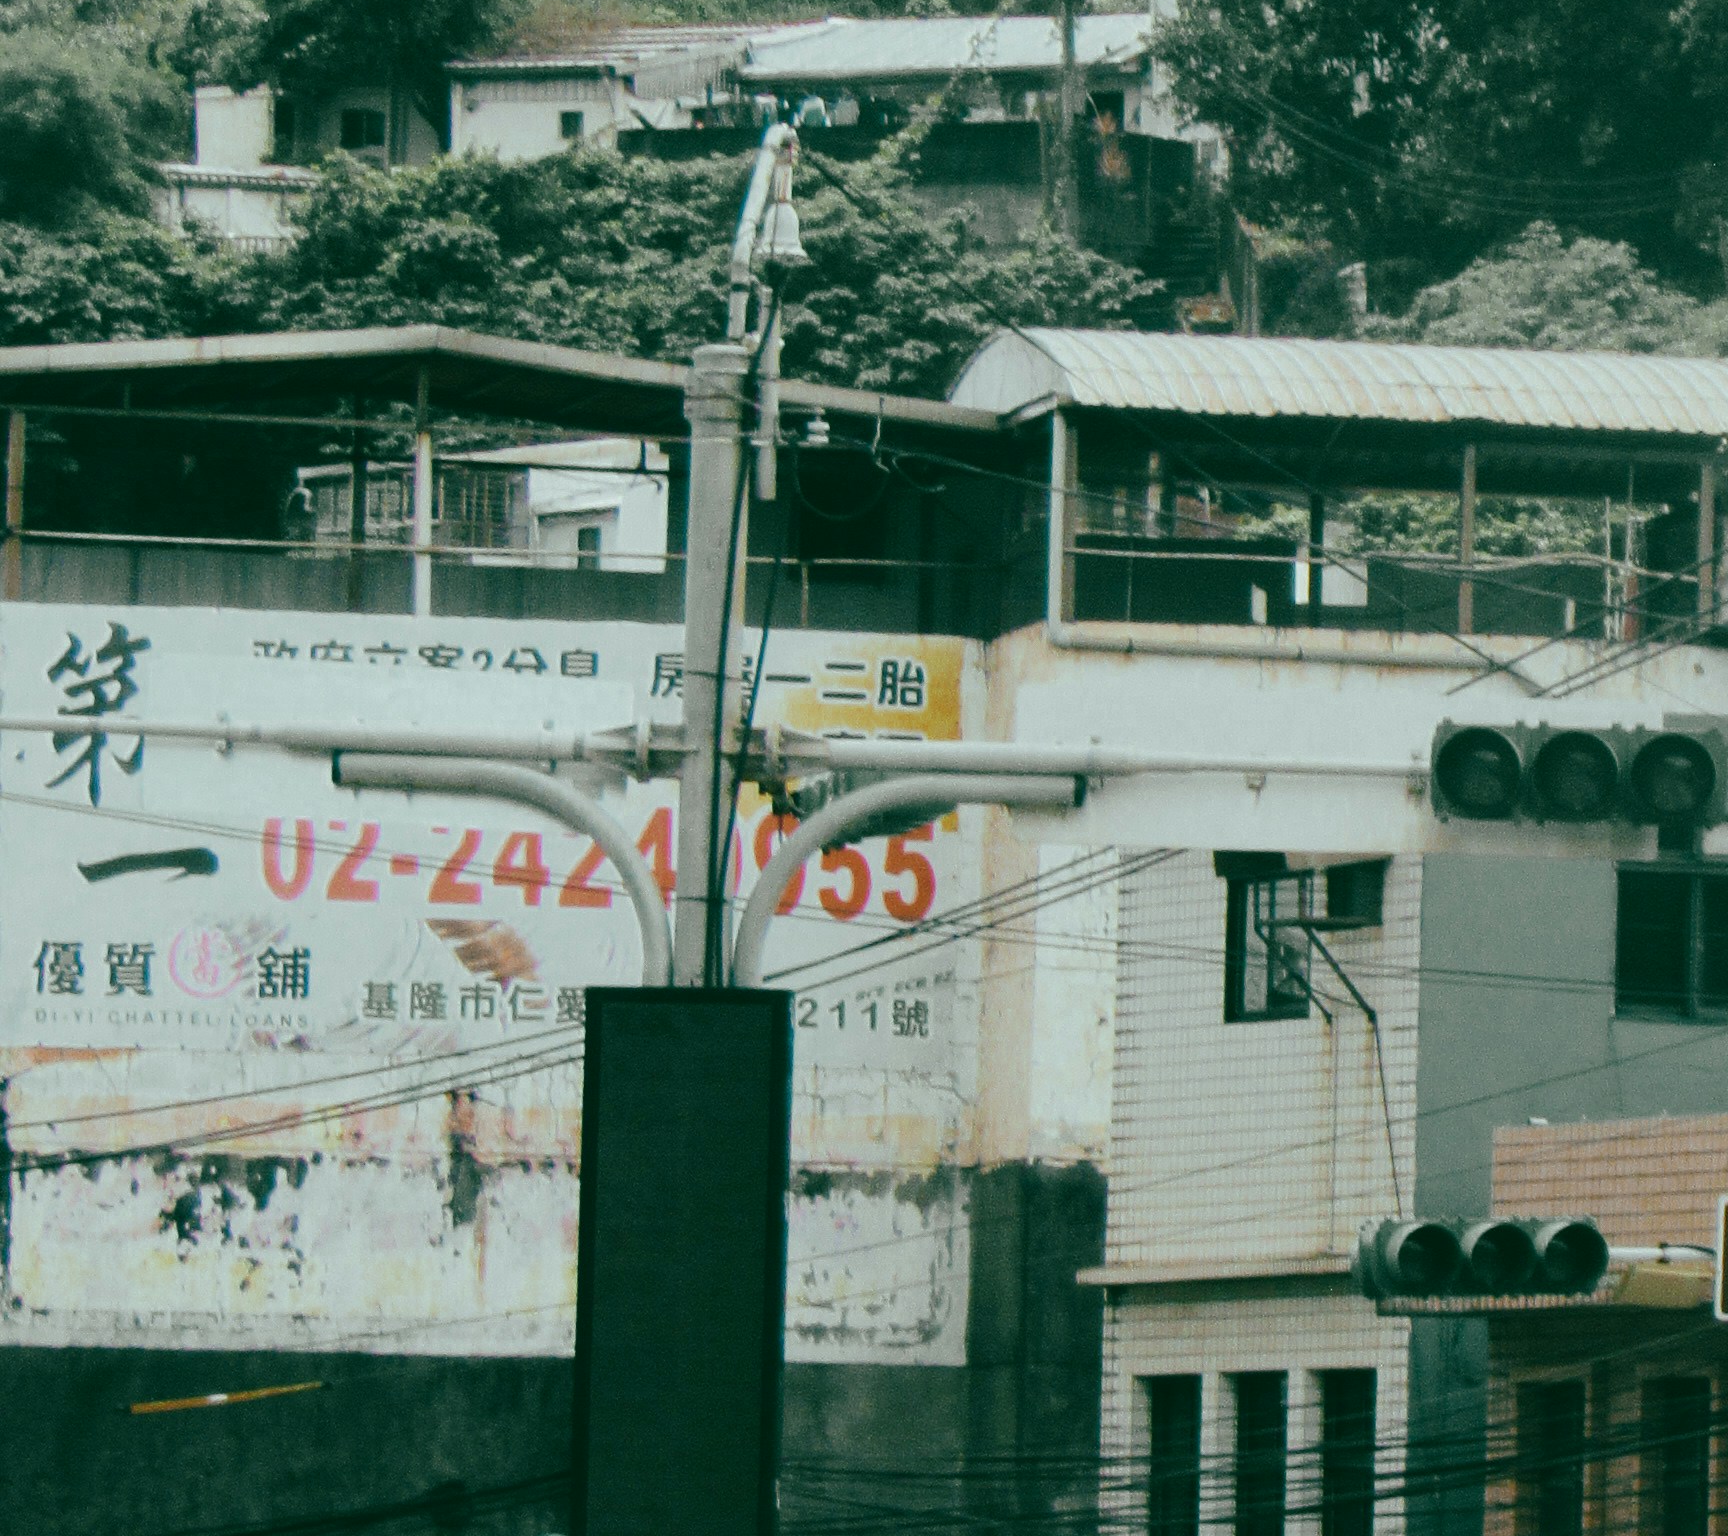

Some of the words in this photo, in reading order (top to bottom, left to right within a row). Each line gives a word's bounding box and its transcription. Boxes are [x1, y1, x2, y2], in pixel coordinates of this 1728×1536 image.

[650, 651, 925, 711] 房一二胎
[46, 620, 219, 884] 第一
[260, 806, 936, 923] 02-2424955
